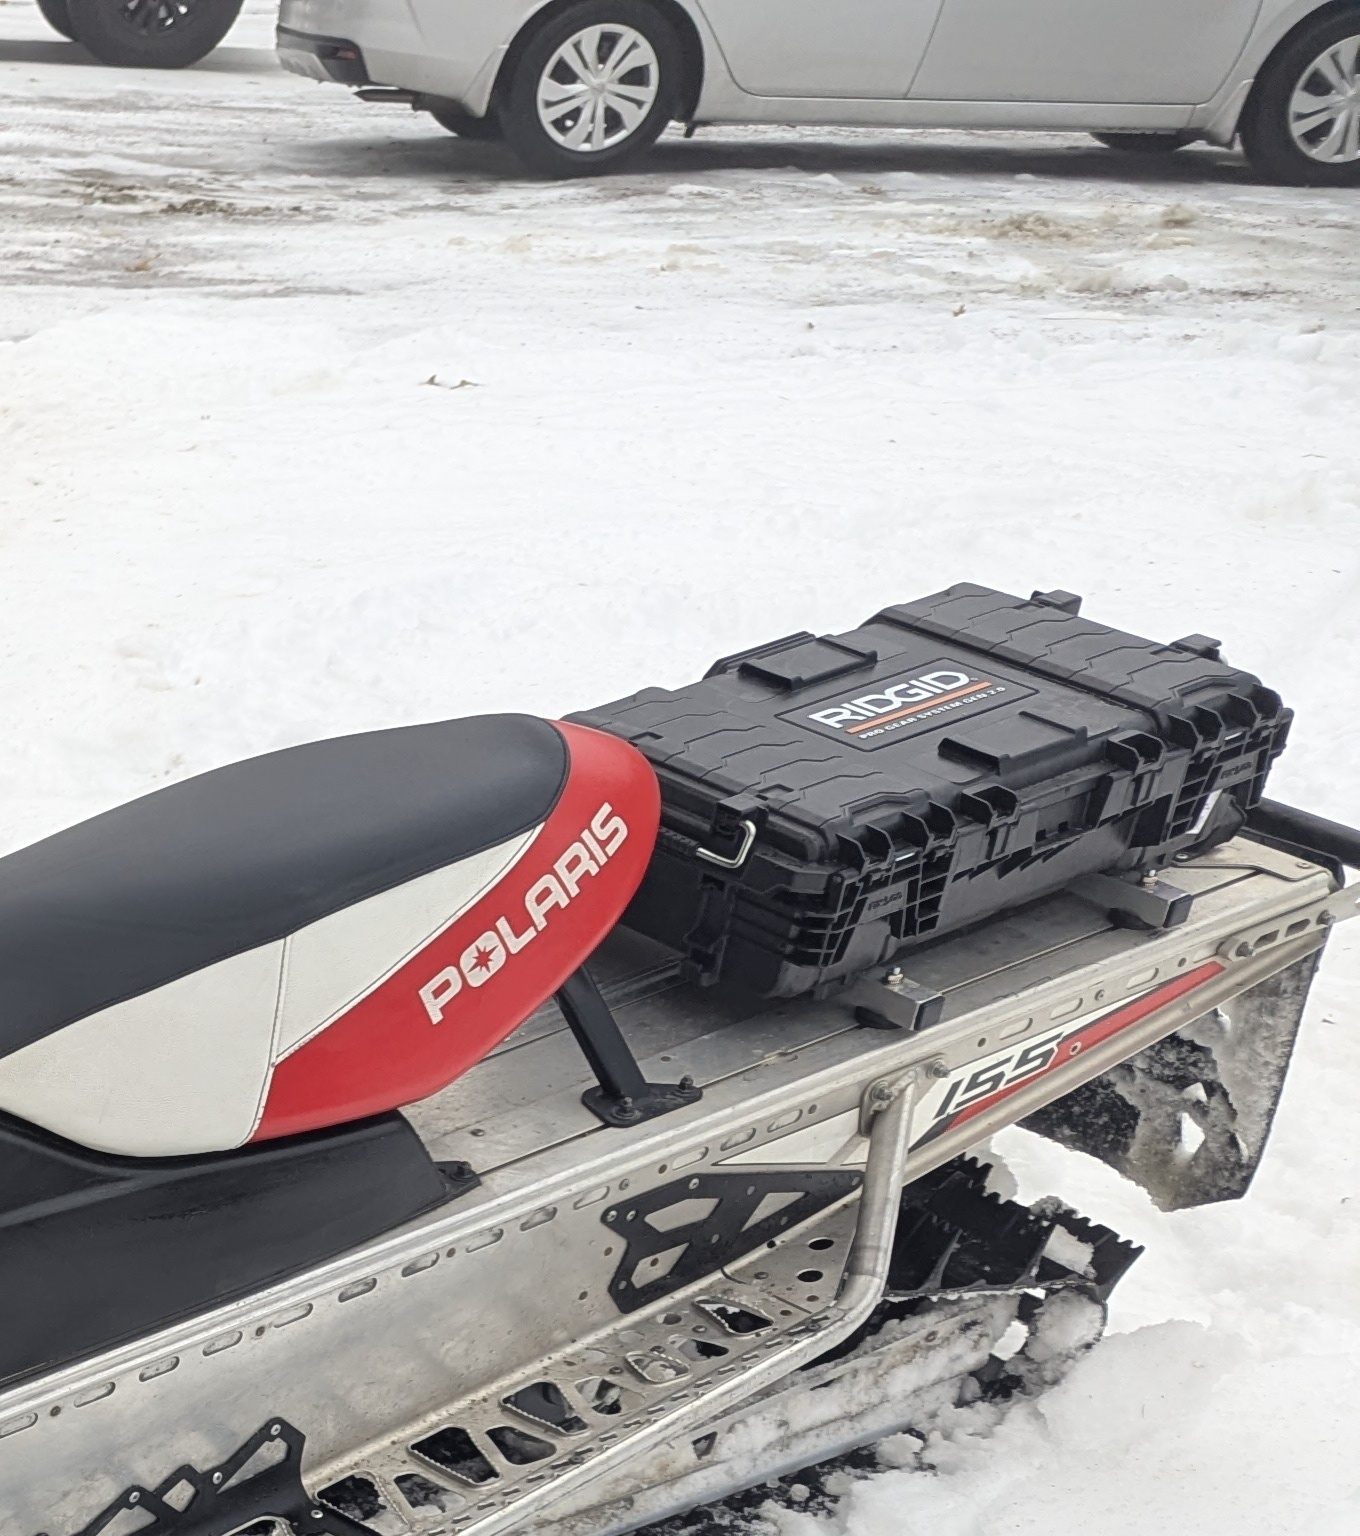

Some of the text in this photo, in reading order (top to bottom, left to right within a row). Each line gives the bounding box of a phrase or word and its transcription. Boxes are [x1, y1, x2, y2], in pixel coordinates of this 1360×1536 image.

[807, 670, 972, 729] RIDGID
[858, 728, 885, 739] PRO
[884, 717, 918, 731] GEAR
[916, 701, 963, 719] SYSTEM
[418, 802, 638, 1025] POLARIS
[934, 1031, 1065, 1120] 155
